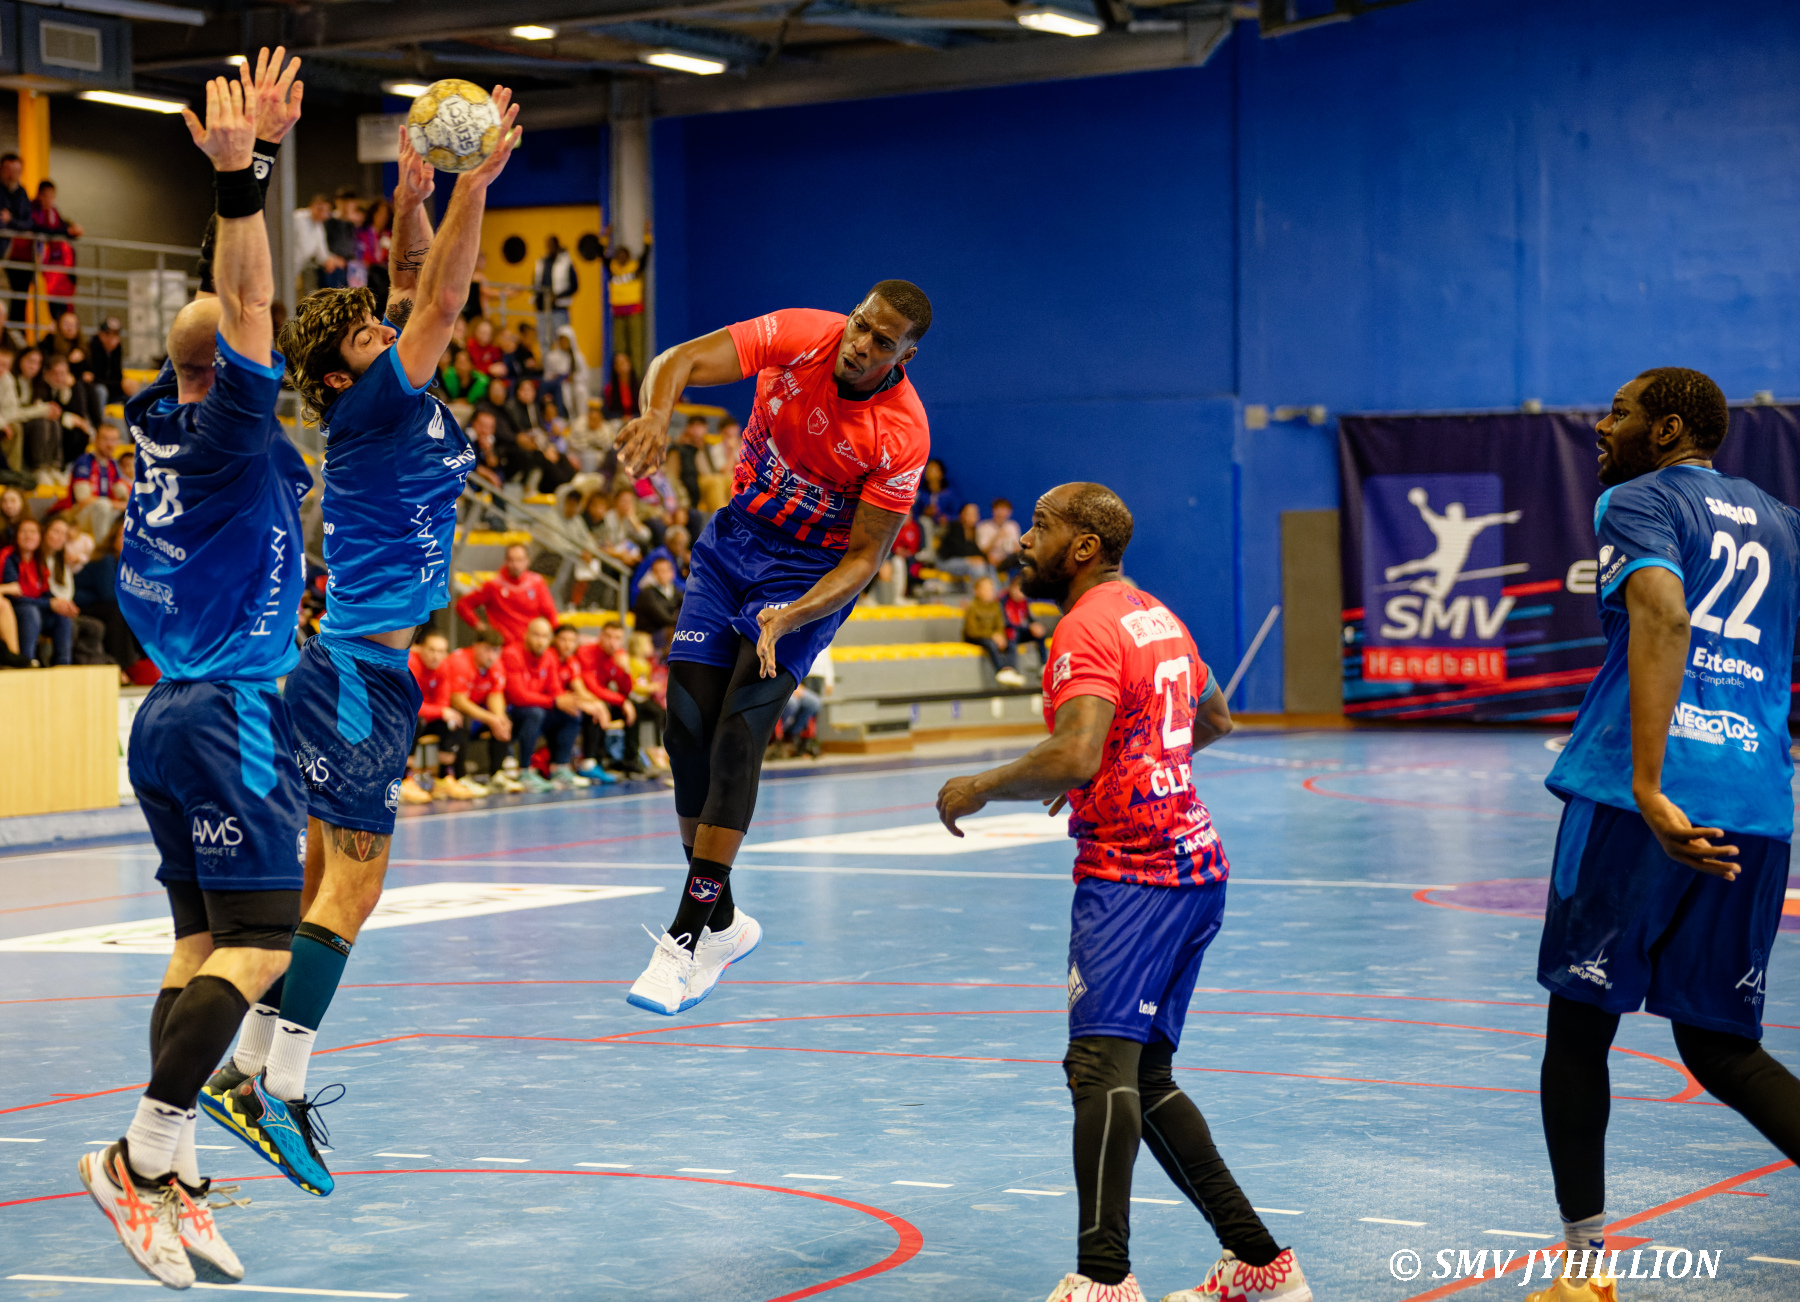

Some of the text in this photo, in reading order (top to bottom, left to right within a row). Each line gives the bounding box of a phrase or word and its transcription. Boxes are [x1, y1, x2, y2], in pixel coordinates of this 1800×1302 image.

[446, 100, 476, 151] SELECT
[249, 525, 287, 636] FINAXY
[1600, 554, 1628, 586] SOURCE
[1689, 530, 1771, 645] 22
[1380, 595, 1517, 640] SMV
[1369, 652, 1502, 677] Handball
[1692, 647, 1764, 682] Extenso
[1742, 739, 1759, 753] 37
[192, 816, 243, 846] AMS
[695, 878, 720, 890] SMV
